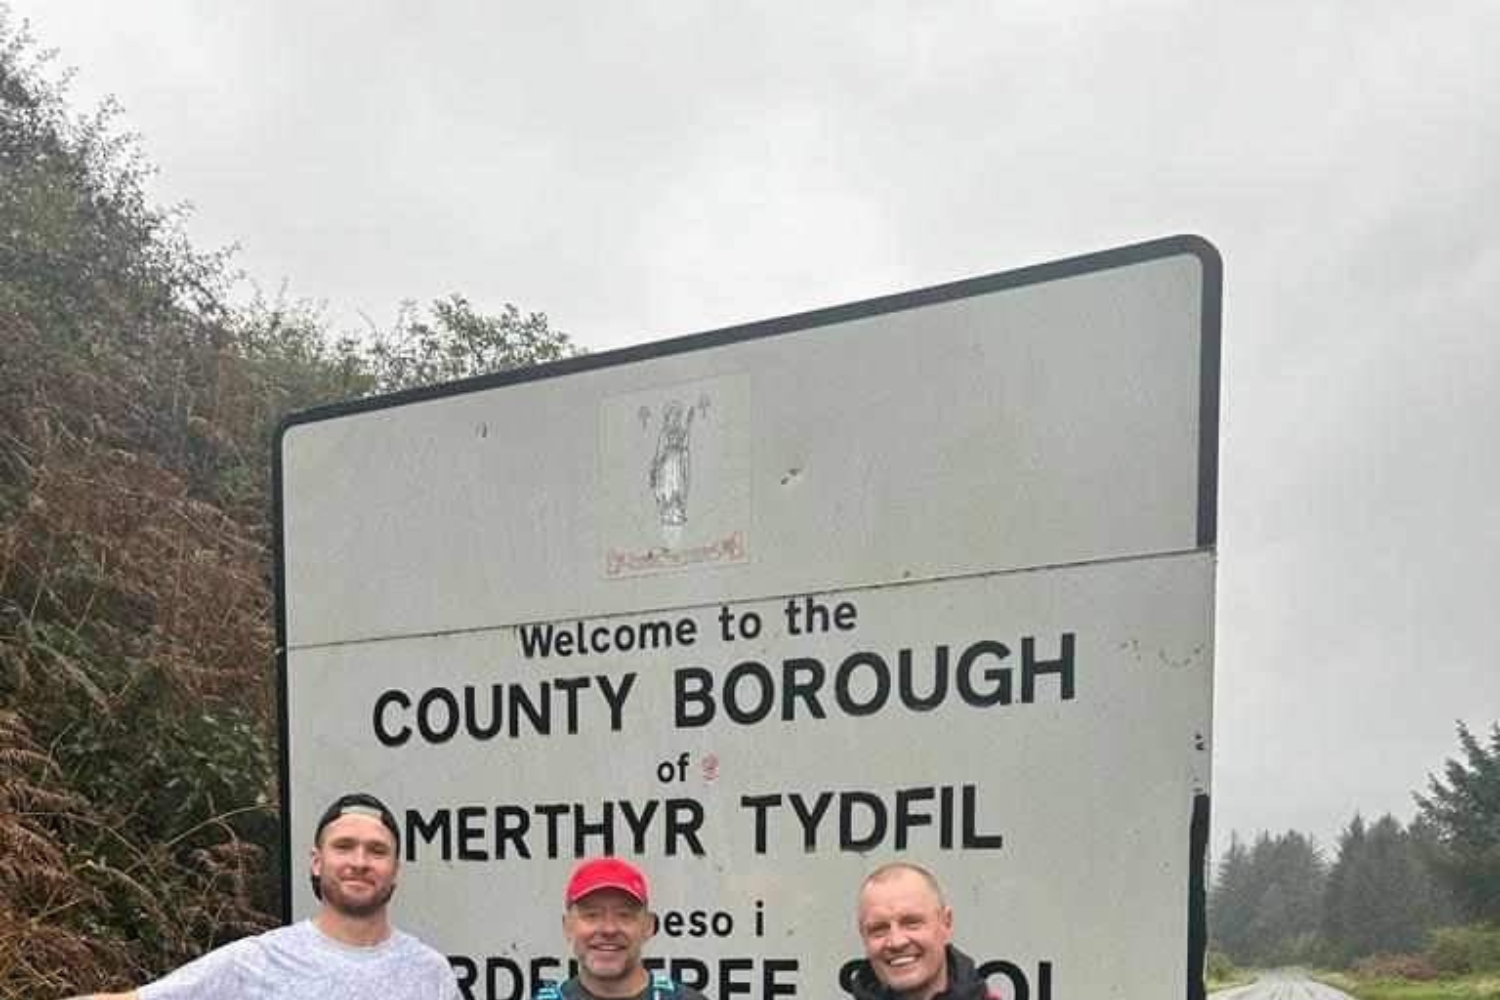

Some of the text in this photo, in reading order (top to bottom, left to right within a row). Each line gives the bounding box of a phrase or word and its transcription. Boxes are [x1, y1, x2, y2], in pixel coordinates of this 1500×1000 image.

[519, 595, 857, 659] Welcome to the
[373, 633, 1076, 748] COUNTY BOROUGH
[657, 753, 690, 783] of
[405, 785, 1003, 862] MERTHYR TYDFIL
[755, 900, 765, 937] i
